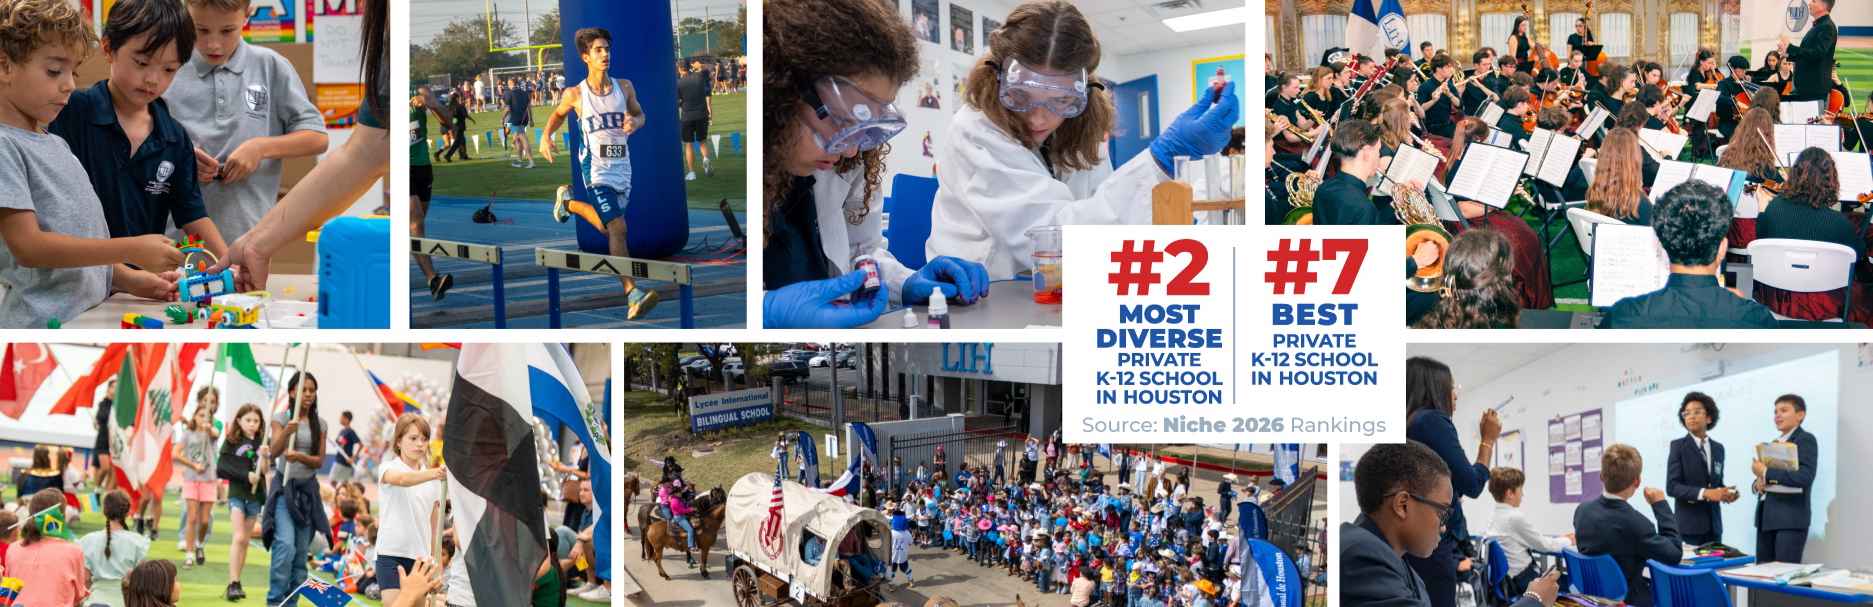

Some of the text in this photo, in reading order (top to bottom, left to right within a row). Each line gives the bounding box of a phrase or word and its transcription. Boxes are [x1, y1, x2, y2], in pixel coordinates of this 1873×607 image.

[942, 343, 993, 375] LIH
[721, 391, 769, 405] International
[696, 407, 771, 427] BILINGUAL SCHOOL
[1274, 552, 1286, 583] Houston
